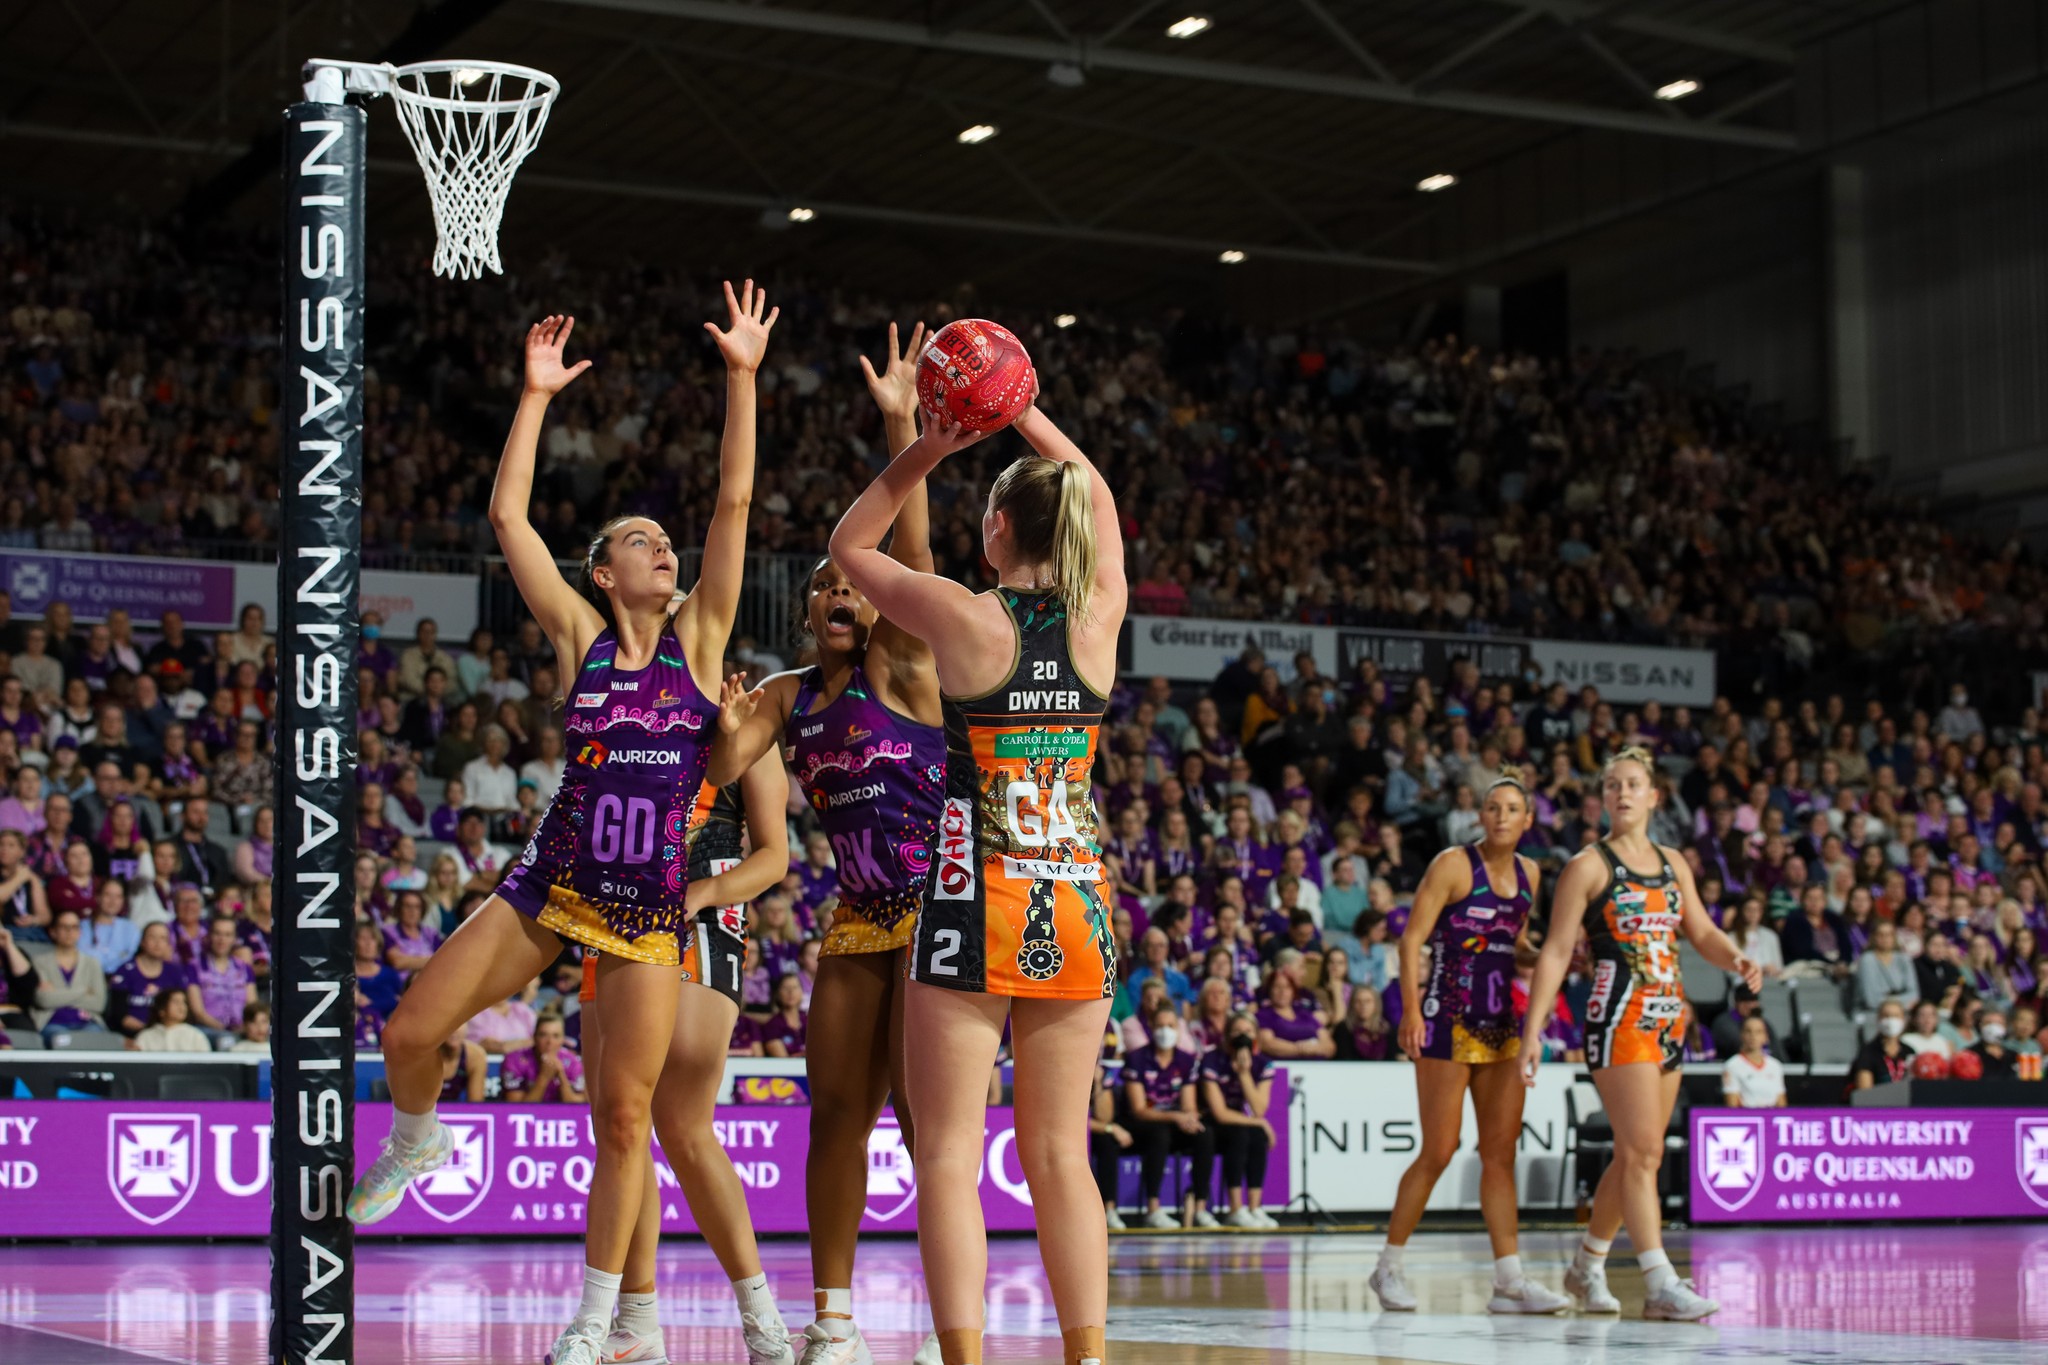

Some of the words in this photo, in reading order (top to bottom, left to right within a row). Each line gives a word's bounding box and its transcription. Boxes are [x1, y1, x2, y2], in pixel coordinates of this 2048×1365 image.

[299, 120, 345, 496] NISSAN
[1259, 629, 1314, 651] Mail
[1032, 660, 1058, 681] 20
[1554, 660, 1694, 689] NISSAN
[611, 680, 638, 691] VALOUR
[1008, 690, 1081, 711] DWYER
[295, 547, 341, 929] NISSAN
[800, 723, 824, 738] VALOUR
[1001, 735, 1050, 745] CARROLL
[1053, 735, 1060, 745] &
[1062, 735, 1086, 745] O'DEA
[607, 750, 681, 765] AURIZON
[1025, 746, 1069, 756] LAWYERS
[829, 782, 887, 807] AURIZON
[1006, 780, 1087, 848] GA
[591, 793, 656, 865] GD
[832, 827, 895, 893] GK
[1016, 862, 1095, 875] PIMCO
[616, 884, 639, 899] UQ
[930, 928, 962, 976] 2
[1649, 941, 1675, 983] C
[1487, 970, 1504, 1014] C
[1587, 1034, 1600, 1063] 5
[508, 1114, 579, 1147] THE
[1313, 1121, 1552, 1152] NISN
[1772, 1116, 1827, 1146] THE
[1830, 1116, 1974, 1146] UNIVERSITY
[296, 981, 348, 1365] NISSAN
[507, 1155, 557, 1189] OF
[1773, 1152, 1812, 1182] OF
[1814, 1152, 1975, 1187] QUEENSLAND
[1776, 1192, 1902, 1209] AUSTRALIA
